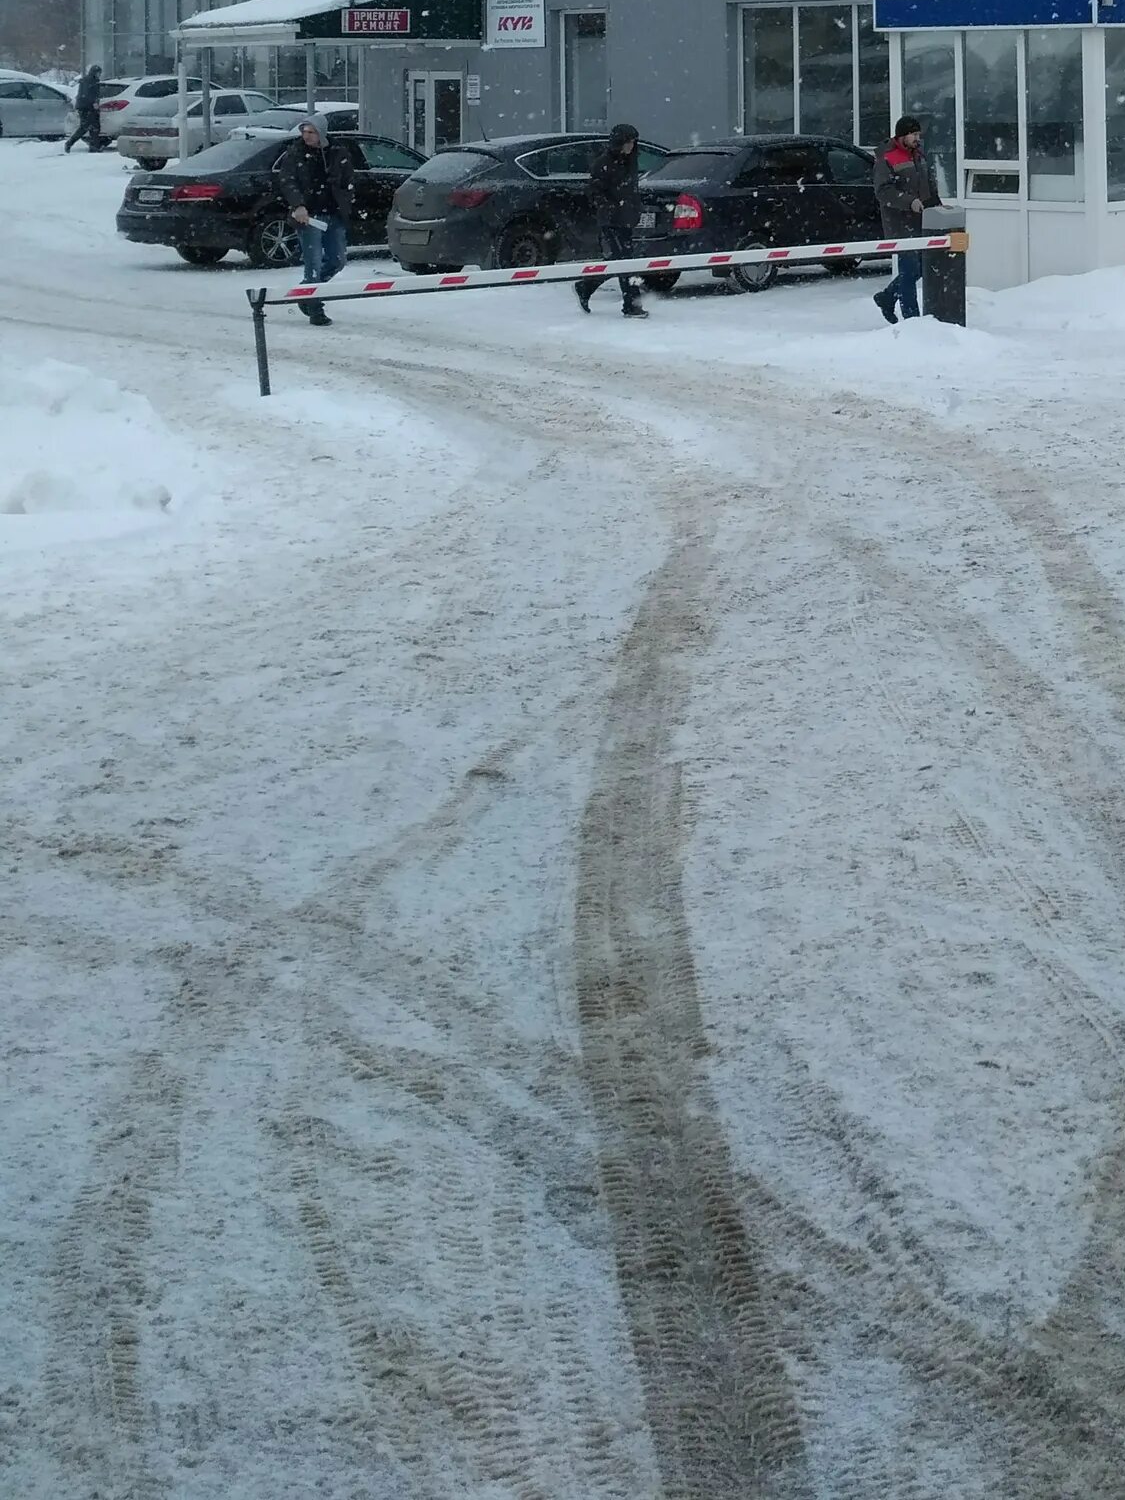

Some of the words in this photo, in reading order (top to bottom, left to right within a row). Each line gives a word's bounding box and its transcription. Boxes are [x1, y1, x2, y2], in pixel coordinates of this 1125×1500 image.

[353, 11, 386, 21] ПРИЕМ
[387, 11, 400, 21] НА
[354, 21, 401, 31] РЕМОНТ
[498, 16, 534, 31] KYB
